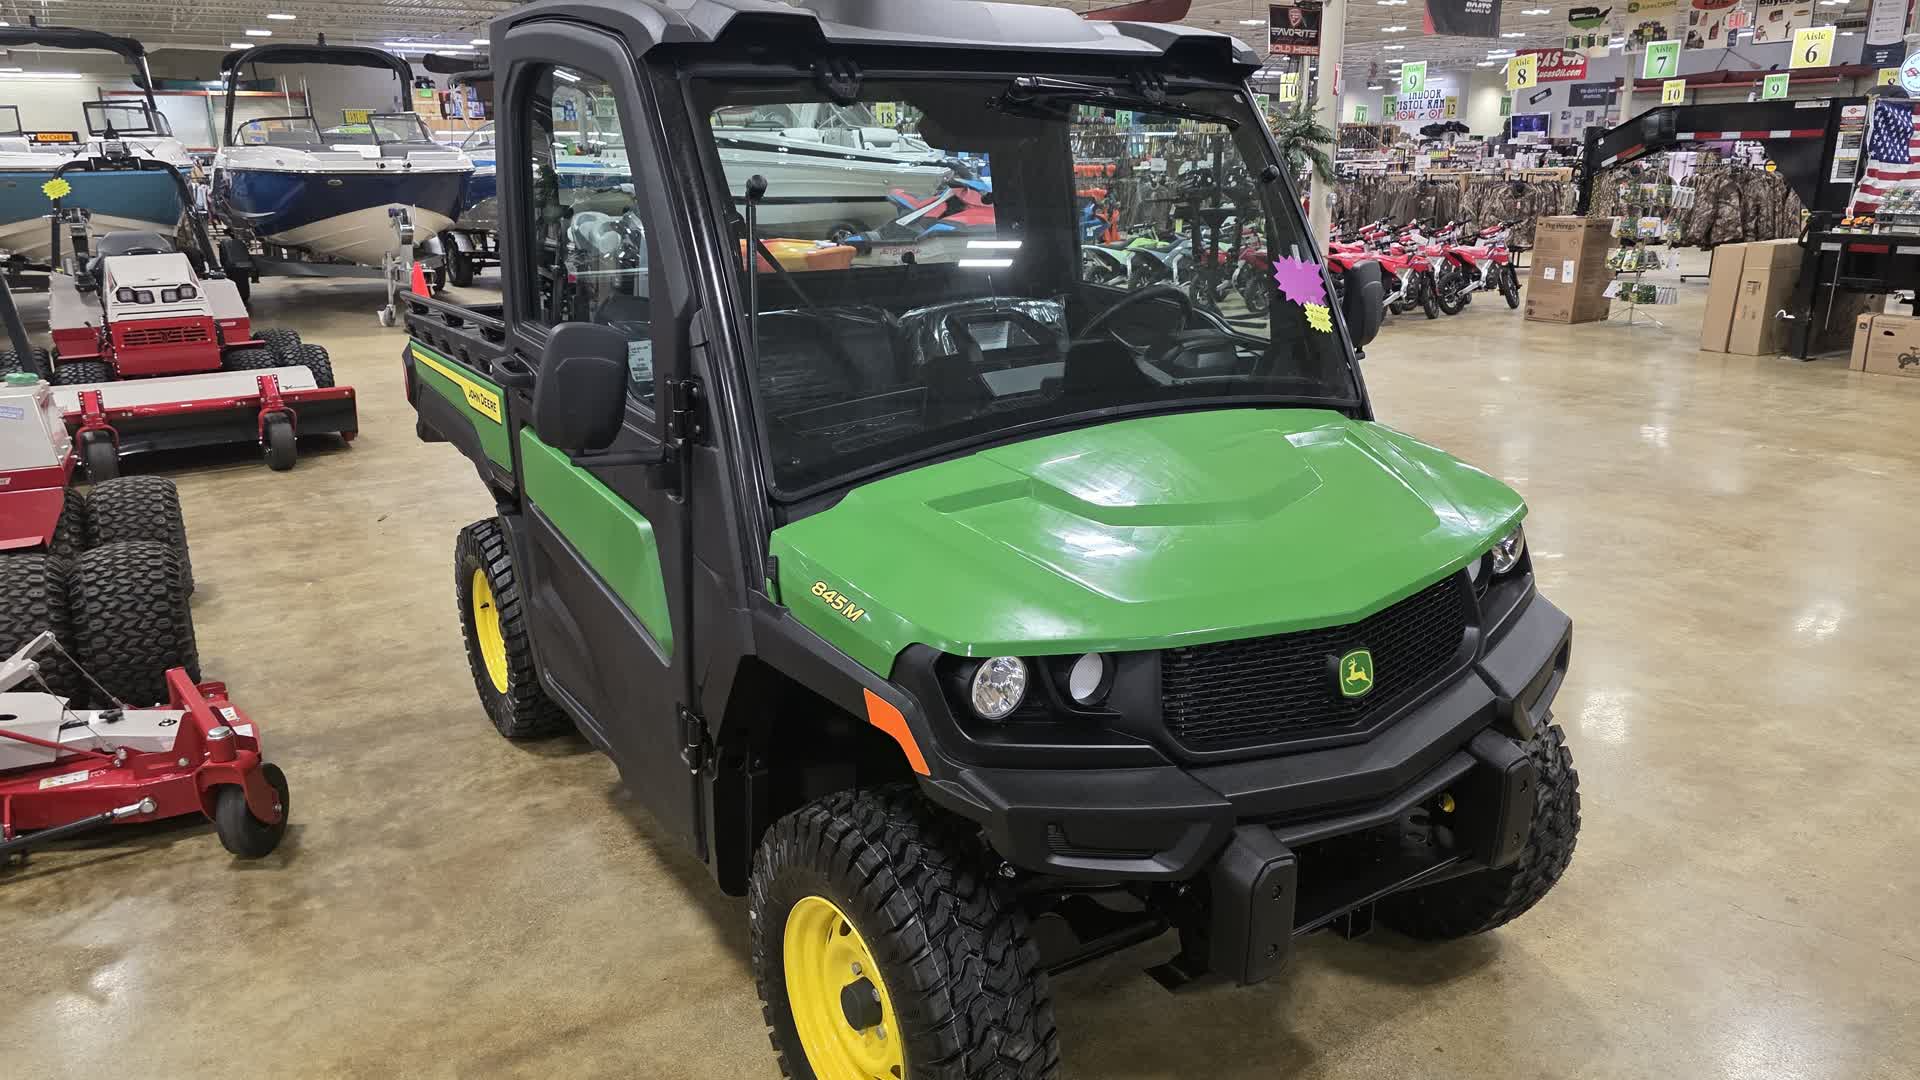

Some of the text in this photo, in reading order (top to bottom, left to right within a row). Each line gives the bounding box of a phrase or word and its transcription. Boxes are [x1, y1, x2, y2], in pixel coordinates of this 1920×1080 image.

[1270, 27, 1317, 38] FAVORITE
[1804, 32, 1826, 40] Aisle
[1269, 44, 1319, 54] SOLD HERE
[1805, 43, 1820, 63] 6
[1516, 58, 1530, 66] Aisle
[1537, 52, 1560, 67] CAS
[1657, 56, 1667, 74] 7
[1409, 75, 1417, 89] 9
[1518, 69, 1527, 85] 8
[1285, 85, 1298, 98] 10
[1668, 89, 1681, 101] 10
[1772, 83, 1780, 95] 9
[1385, 103, 1395, 115] 13
[1397, 100, 1424, 110] ISTOL
[1447, 104, 1456, 115] 12
[881, 111, 893, 124] 18
[469, 389, 497, 413] JOHN DEERE
[811, 581, 866, 622] 845M
